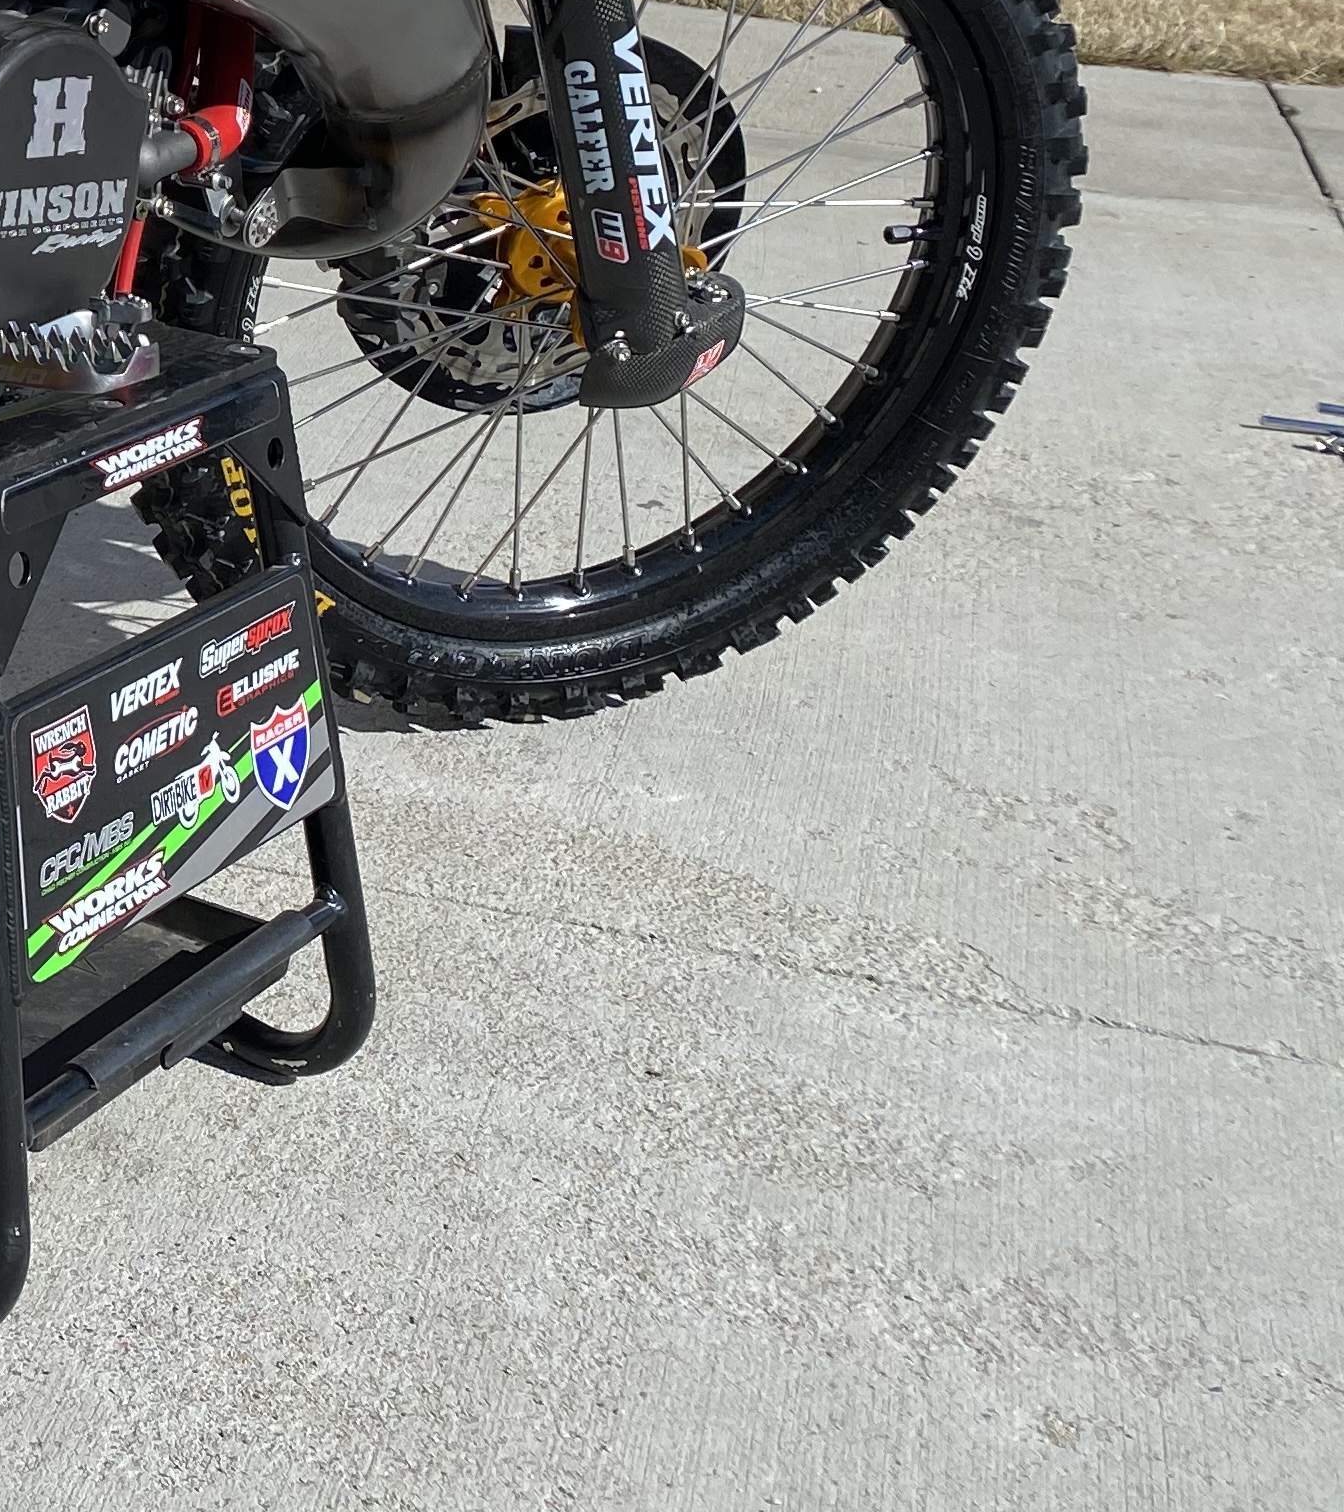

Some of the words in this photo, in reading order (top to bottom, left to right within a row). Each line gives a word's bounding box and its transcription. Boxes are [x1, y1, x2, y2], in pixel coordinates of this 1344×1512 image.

[26, 75, 93, 159] H
[564, 60, 615, 194] GALFER
[613, 29, 676, 251] VERTEX
[32, 216, 124, 236] COMPONENTS
[628, 176, 650, 251] PISTONS
[96, 418, 201, 473] WORKS
[104, 437, 203, 488] CONNECTION
[200, 605, 293, 676] Supersprox
[111, 658, 183, 723] VERTEX
[233, 649, 300, 702] ELUSIVE
[35, 713, 88, 755] WRENCH
[114, 706, 199, 776] COMETIC
[255, 711, 305, 748] RACER
[46, 779, 91, 815] RABBIT
[116, 761, 151, 784] GASKET
[267, 735, 300, 795] X
[39, 811, 135, 890] CFC/MBS
[48, 850, 165, 932] WORKS
[58, 872, 170, 954] CONNECTION
